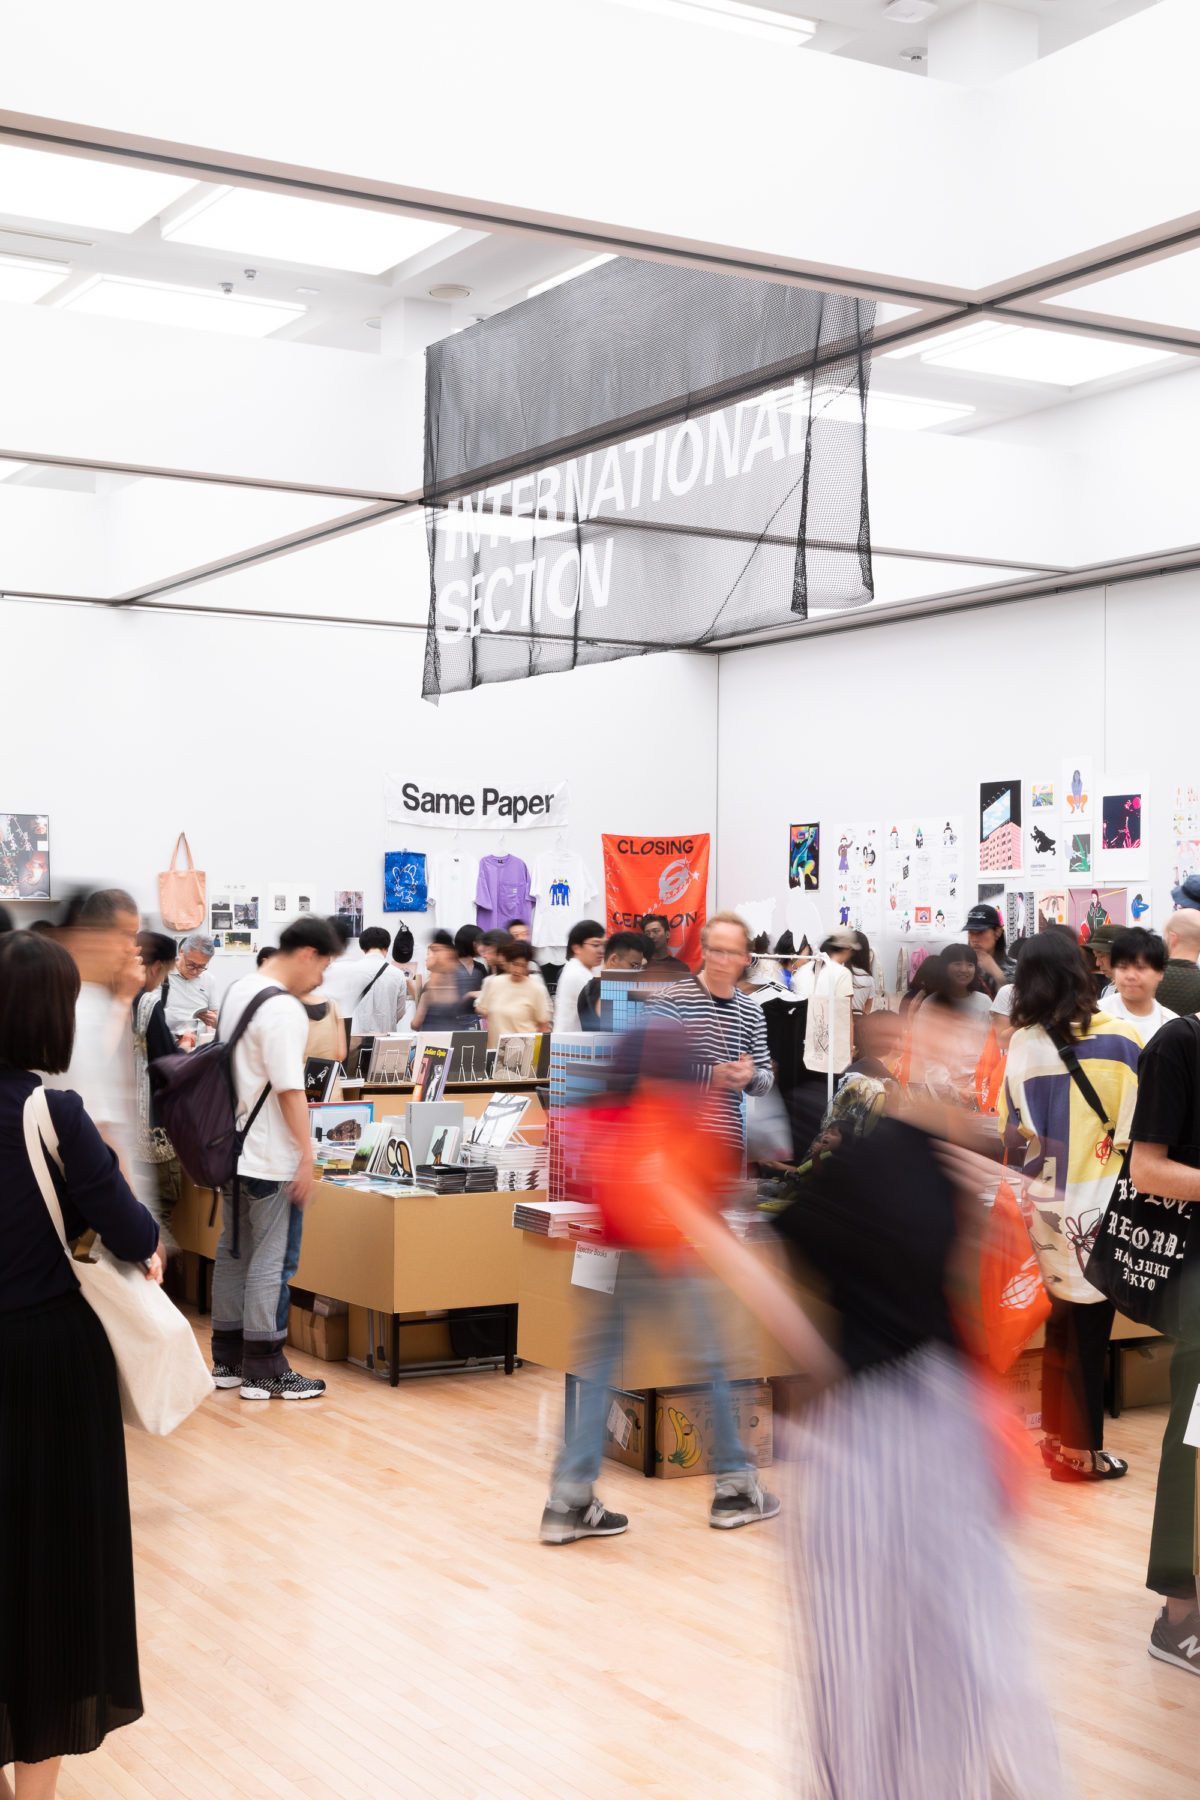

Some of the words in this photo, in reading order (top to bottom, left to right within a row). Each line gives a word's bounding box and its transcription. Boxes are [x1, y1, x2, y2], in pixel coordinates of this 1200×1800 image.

[444, 377, 807, 562] INTERNATIONAL
[435, 537, 614, 644] SECTION
[401, 782, 475, 816] Same
[481, 787, 555, 823] Paper
[617, 839, 694, 855] CLOSING
